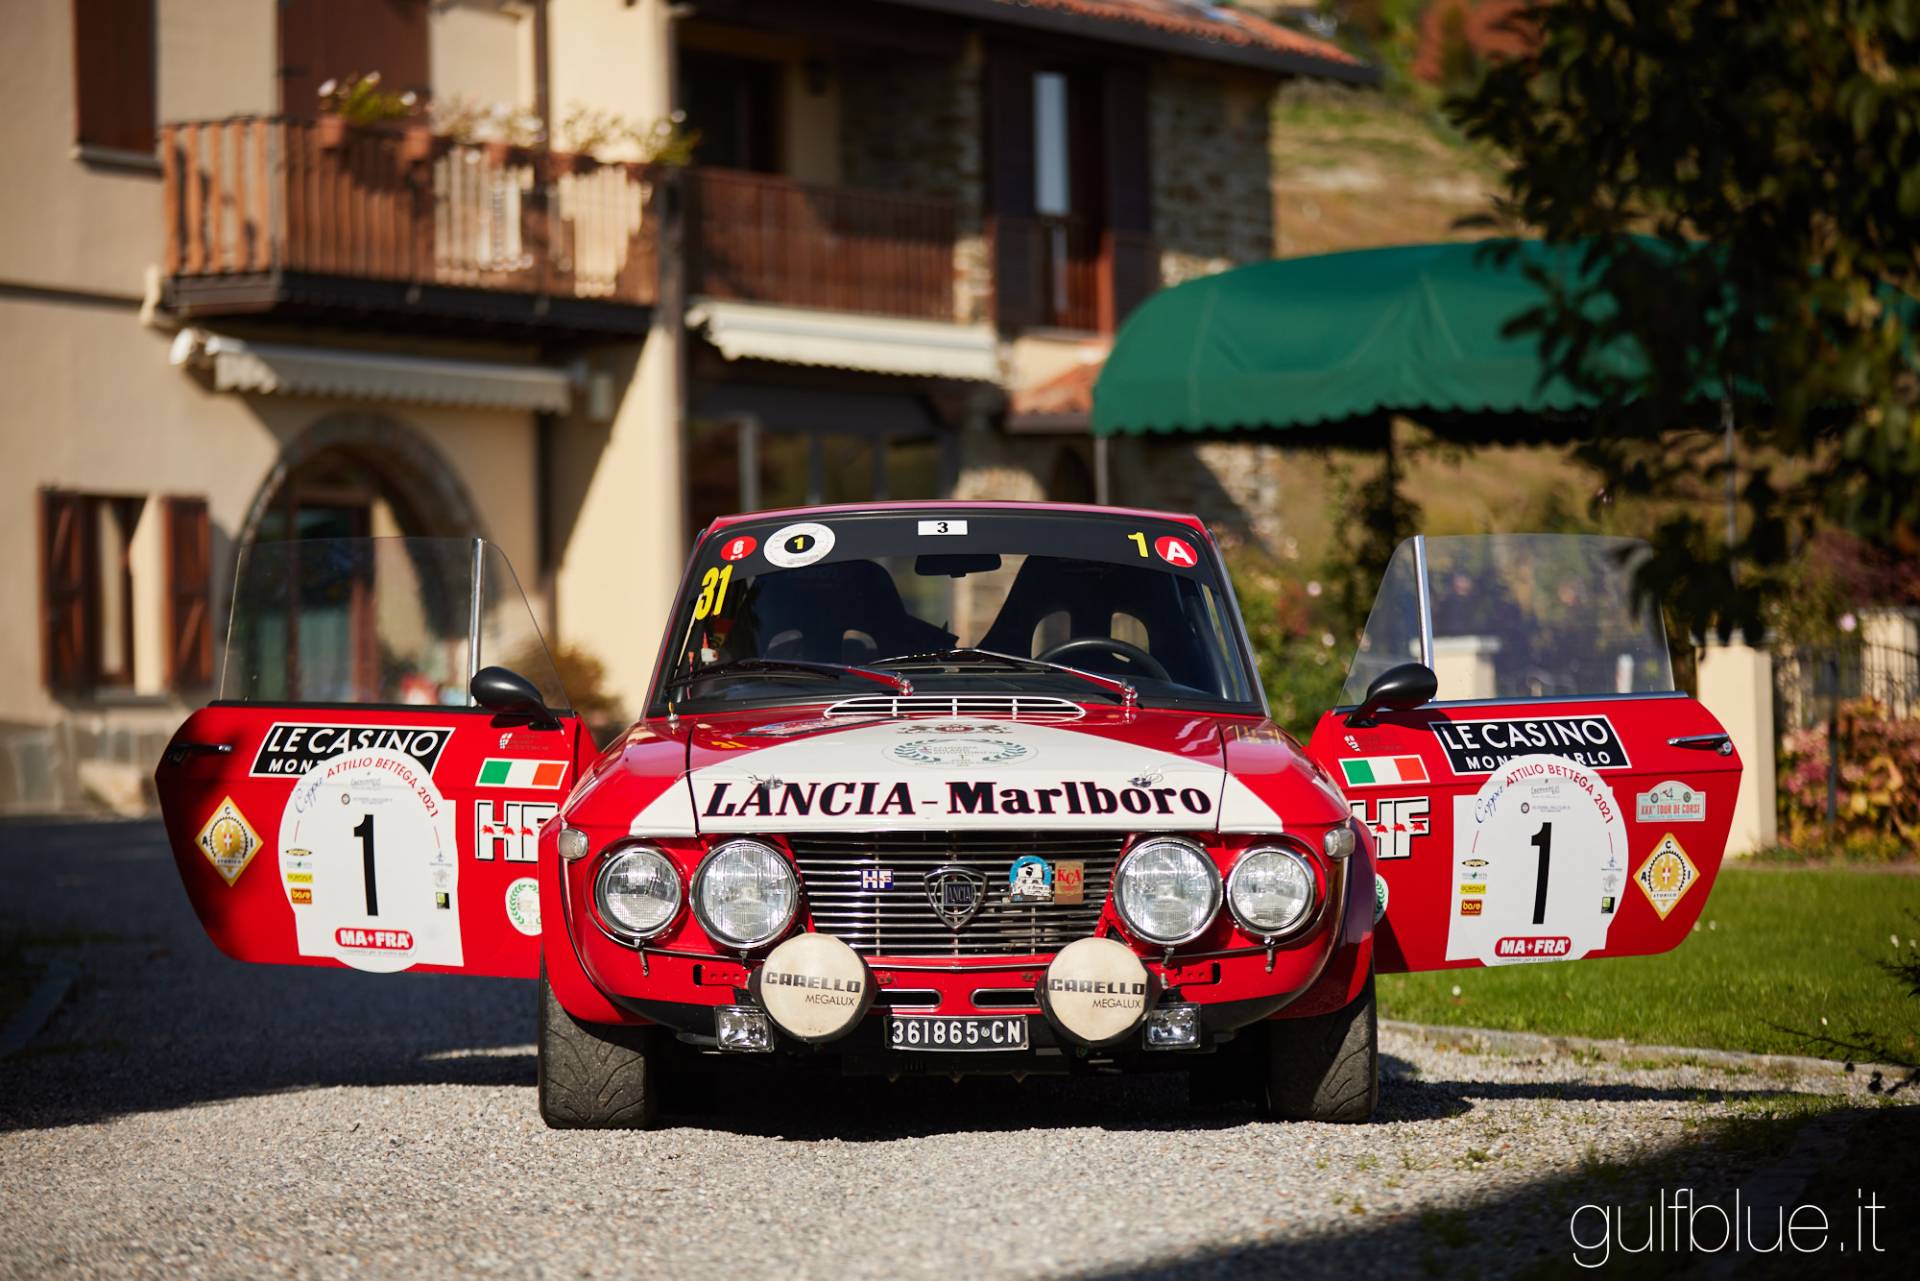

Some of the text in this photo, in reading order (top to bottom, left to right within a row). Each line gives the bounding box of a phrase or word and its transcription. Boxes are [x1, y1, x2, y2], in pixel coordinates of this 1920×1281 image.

[937, 521, 949, 534] 3
[793, 537, 805, 550] 1
[1127, 532, 1149, 558] 1
[1166, 540, 1194, 565] A
[695, 564, 734, 620] 31
[267, 727, 439, 757] LE CASINO
[1440, 720, 1609, 750] LE CASINO
[268, 757, 325, 773] MON
[1465, 754, 1520, 770] MON
[326, 757, 373, 779] ATTILIO
[375, 757, 416, 790] BETTEGA
[417, 786, 439, 818] 2021
[701, 782, 916, 817] LANCIA
[945, 781, 1212, 815] Marlboro
[1506, 763, 1545, 788] ATTILIO
[1547, 764, 1594, 796] BETTEGA
[1593, 793, 1615, 825] 2021
[475, 800, 559, 863] HF
[1350, 796, 1430, 860] HF
[352, 813, 379, 917] 1
[1530, 822, 1553, 925] 1
[1640, 871, 1648, 882] A
[862, 870, 893, 889] HF
[766, 971, 861, 993] CARELLO
[1049, 979, 1145, 995] CARELLO
[805, 994, 855, 1007] MEGALUX
[1092, 998, 1141, 1009] MEGALUX
[892, 1020, 1021, 1044] 361865 CN
